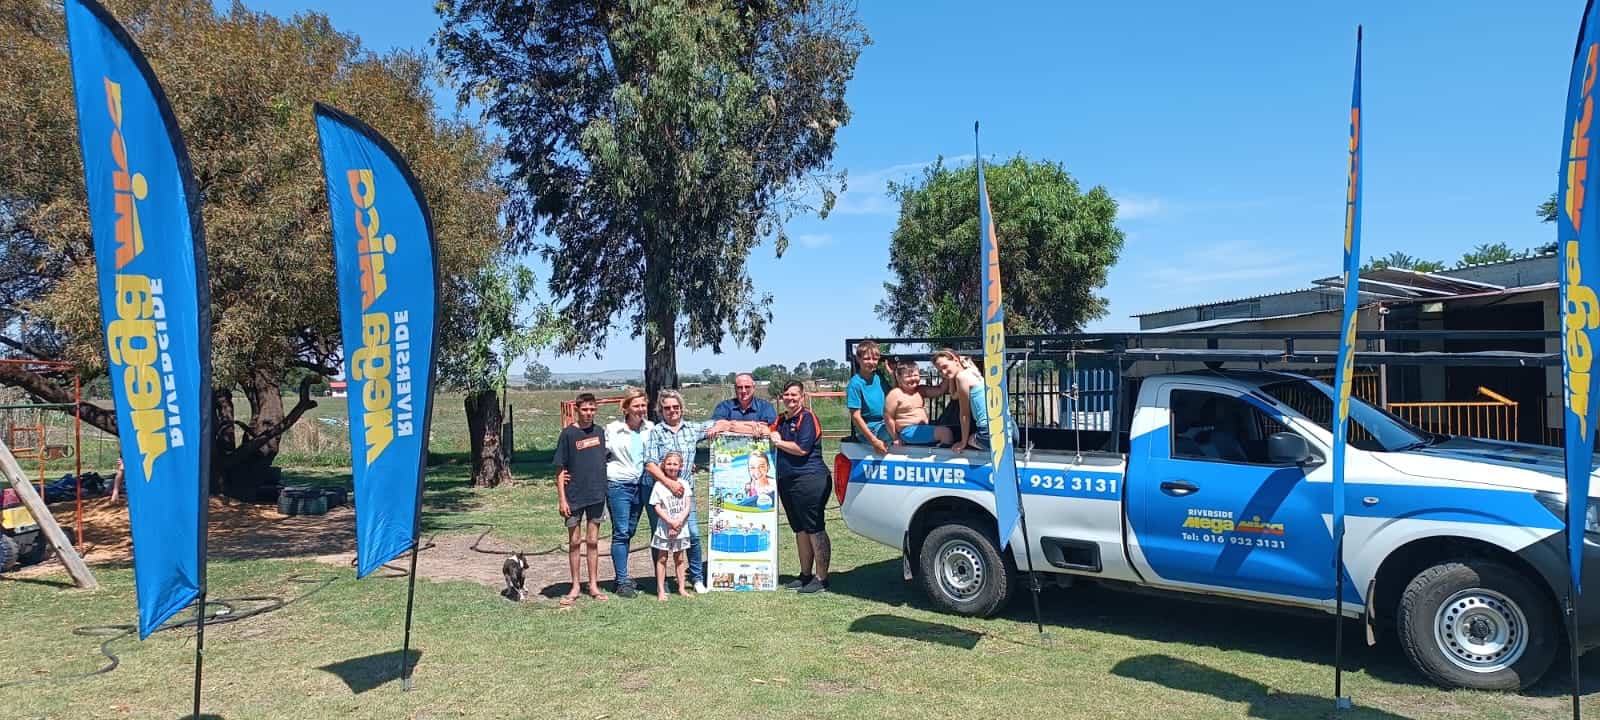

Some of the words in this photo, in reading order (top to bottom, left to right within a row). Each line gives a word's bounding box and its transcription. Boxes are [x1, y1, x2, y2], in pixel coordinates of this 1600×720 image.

[862, 463, 888, 481] WE
[893, 465, 967, 485] DELIVER
[1030, 474, 1065, 490] 932
[1071, 476, 1117, 494] 3131
[1187, 508, 1234, 519] RIVERSIDE
[1181, 532, 1200, 541] Tel:
[1202, 533, 1225, 544] 016
[1229, 536, 1253, 547] 932
[1255, 538, 1286, 549] 3131
